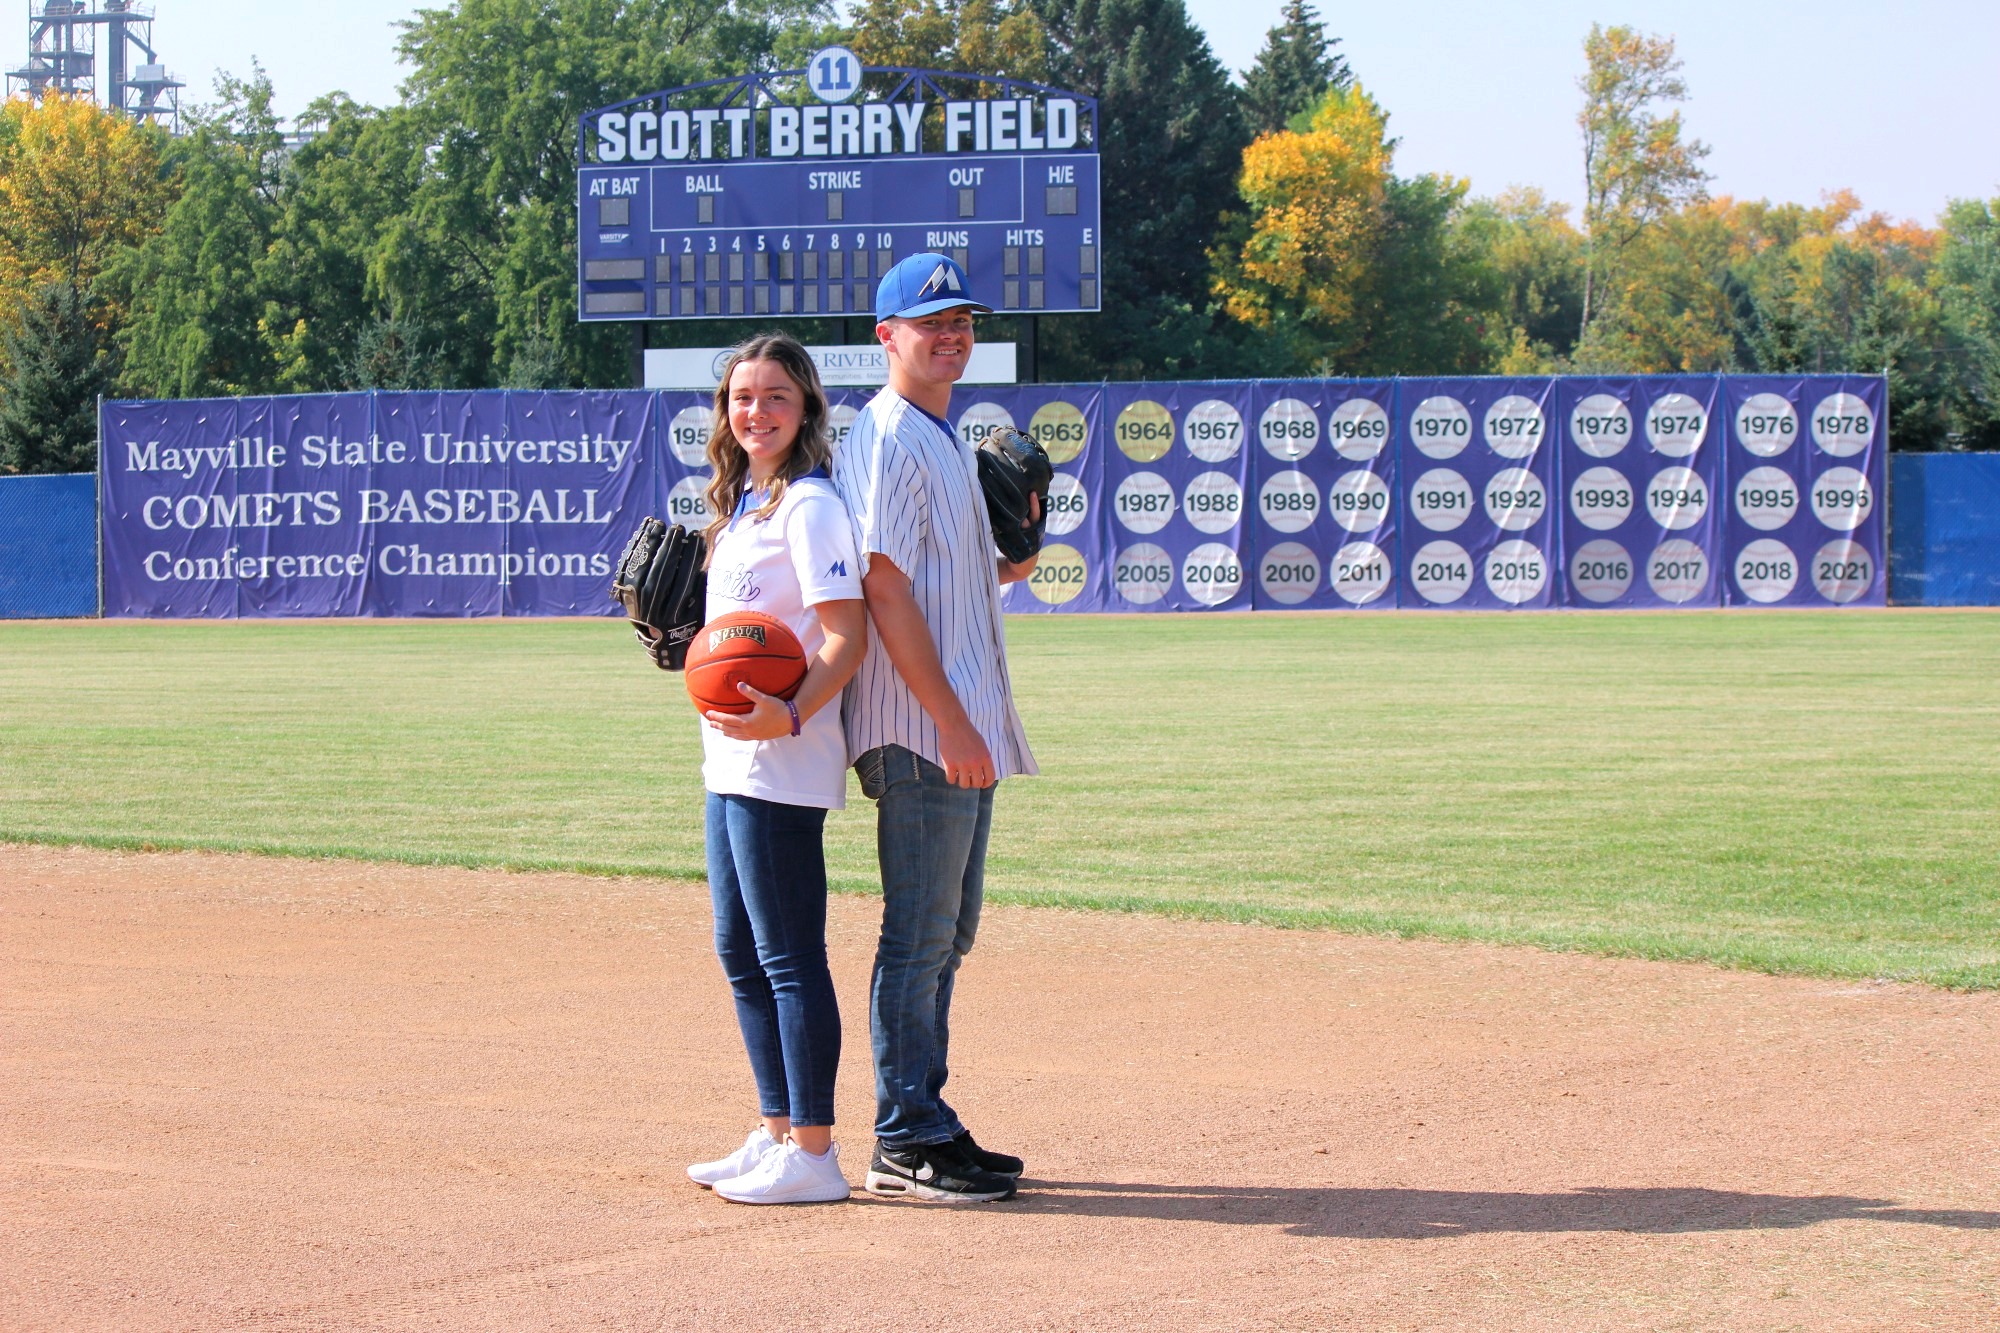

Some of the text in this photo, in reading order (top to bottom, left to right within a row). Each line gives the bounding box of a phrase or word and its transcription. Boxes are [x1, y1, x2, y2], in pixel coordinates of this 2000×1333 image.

[818, 57, 851, 90] 11
[598, 99, 1077, 161] SCOTT BERRY FIELD
[809, 171, 861, 189] STRIKE
[950, 168, 984, 185] OUT
[1049, 166, 1073, 183] H/E
[590, 177, 640, 195] AT BAT
[686, 175, 723, 192] BALL
[599, 233, 622, 241] VARSITY
[684, 237, 691, 252] 2
[709, 237, 716, 252] 3
[732, 236, 740, 251] 4
[758, 235, 765, 251] 5
[783, 235, 790, 250] 6
[807, 234, 814, 249] 7
[832, 234, 839, 249] 8
[857, 233, 864, 248] 9
[878, 233, 891, 248] 10
[927, 231, 968, 247] RUNS
[1007, 230, 1043, 245] HITS
[1084, 228, 1092, 244] E
[660, 238, 665, 253] 1
[824, 353, 883, 368] RIVER
[1031, 424, 1084, 442] 1963
[1119, 423, 1171, 440] 1964
[1189, 422, 1239, 439] 1967
[1264, 421, 1315, 438] 1968
[1333, 420, 1385, 438] 1969
[1416, 419, 1467, 436] 1970
[1490, 418, 1539, 435] 1972
[1577, 417, 1627, 434] 1973
[1652, 416, 1700, 434] 1974
[1743, 416, 1793, 434] 1976
[1817, 416, 1869, 434] 1978
[673, 427, 709, 445] 195
[126, 433, 632, 479] Mayville State University
[670, 497, 706, 515] 198
[1046, 494, 1084, 513] 986
[1120, 495, 1170, 511] 1987
[1188, 494, 1237, 511] 1988
[1264, 493, 1316, 510] 1989
[1333, 492, 1385, 510] 1990
[1418, 491, 1465, 509] 1991
[1490, 490, 1541, 508] 1992
[1576, 490, 1629, 507] 1993
[1651, 489, 1704, 507] 1994
[1741, 490, 1793, 507] 1995
[1816, 490, 1868, 508] 1996
[143, 489, 612, 529] COMETS BASEBALL
[146, 544, 610, 585] Conference Champions
[1340, 564, 1381, 581] 2011
[1418, 564, 1466, 580] 2014
[1492, 563, 1539, 580] 2015
[1579, 562, 1628, 580] 2016
[1654, 562, 1701, 579] 2017
[1743, 562, 1791, 580] 2018
[1820, 562, 1867, 580] 2021
[1031, 566, 1083, 583] 2002
[1117, 565, 1170, 582] 2005
[1187, 565, 1239, 583] 2008
[1266, 565, 1315, 582] 2010
[709, 625, 766, 655] NAIA
